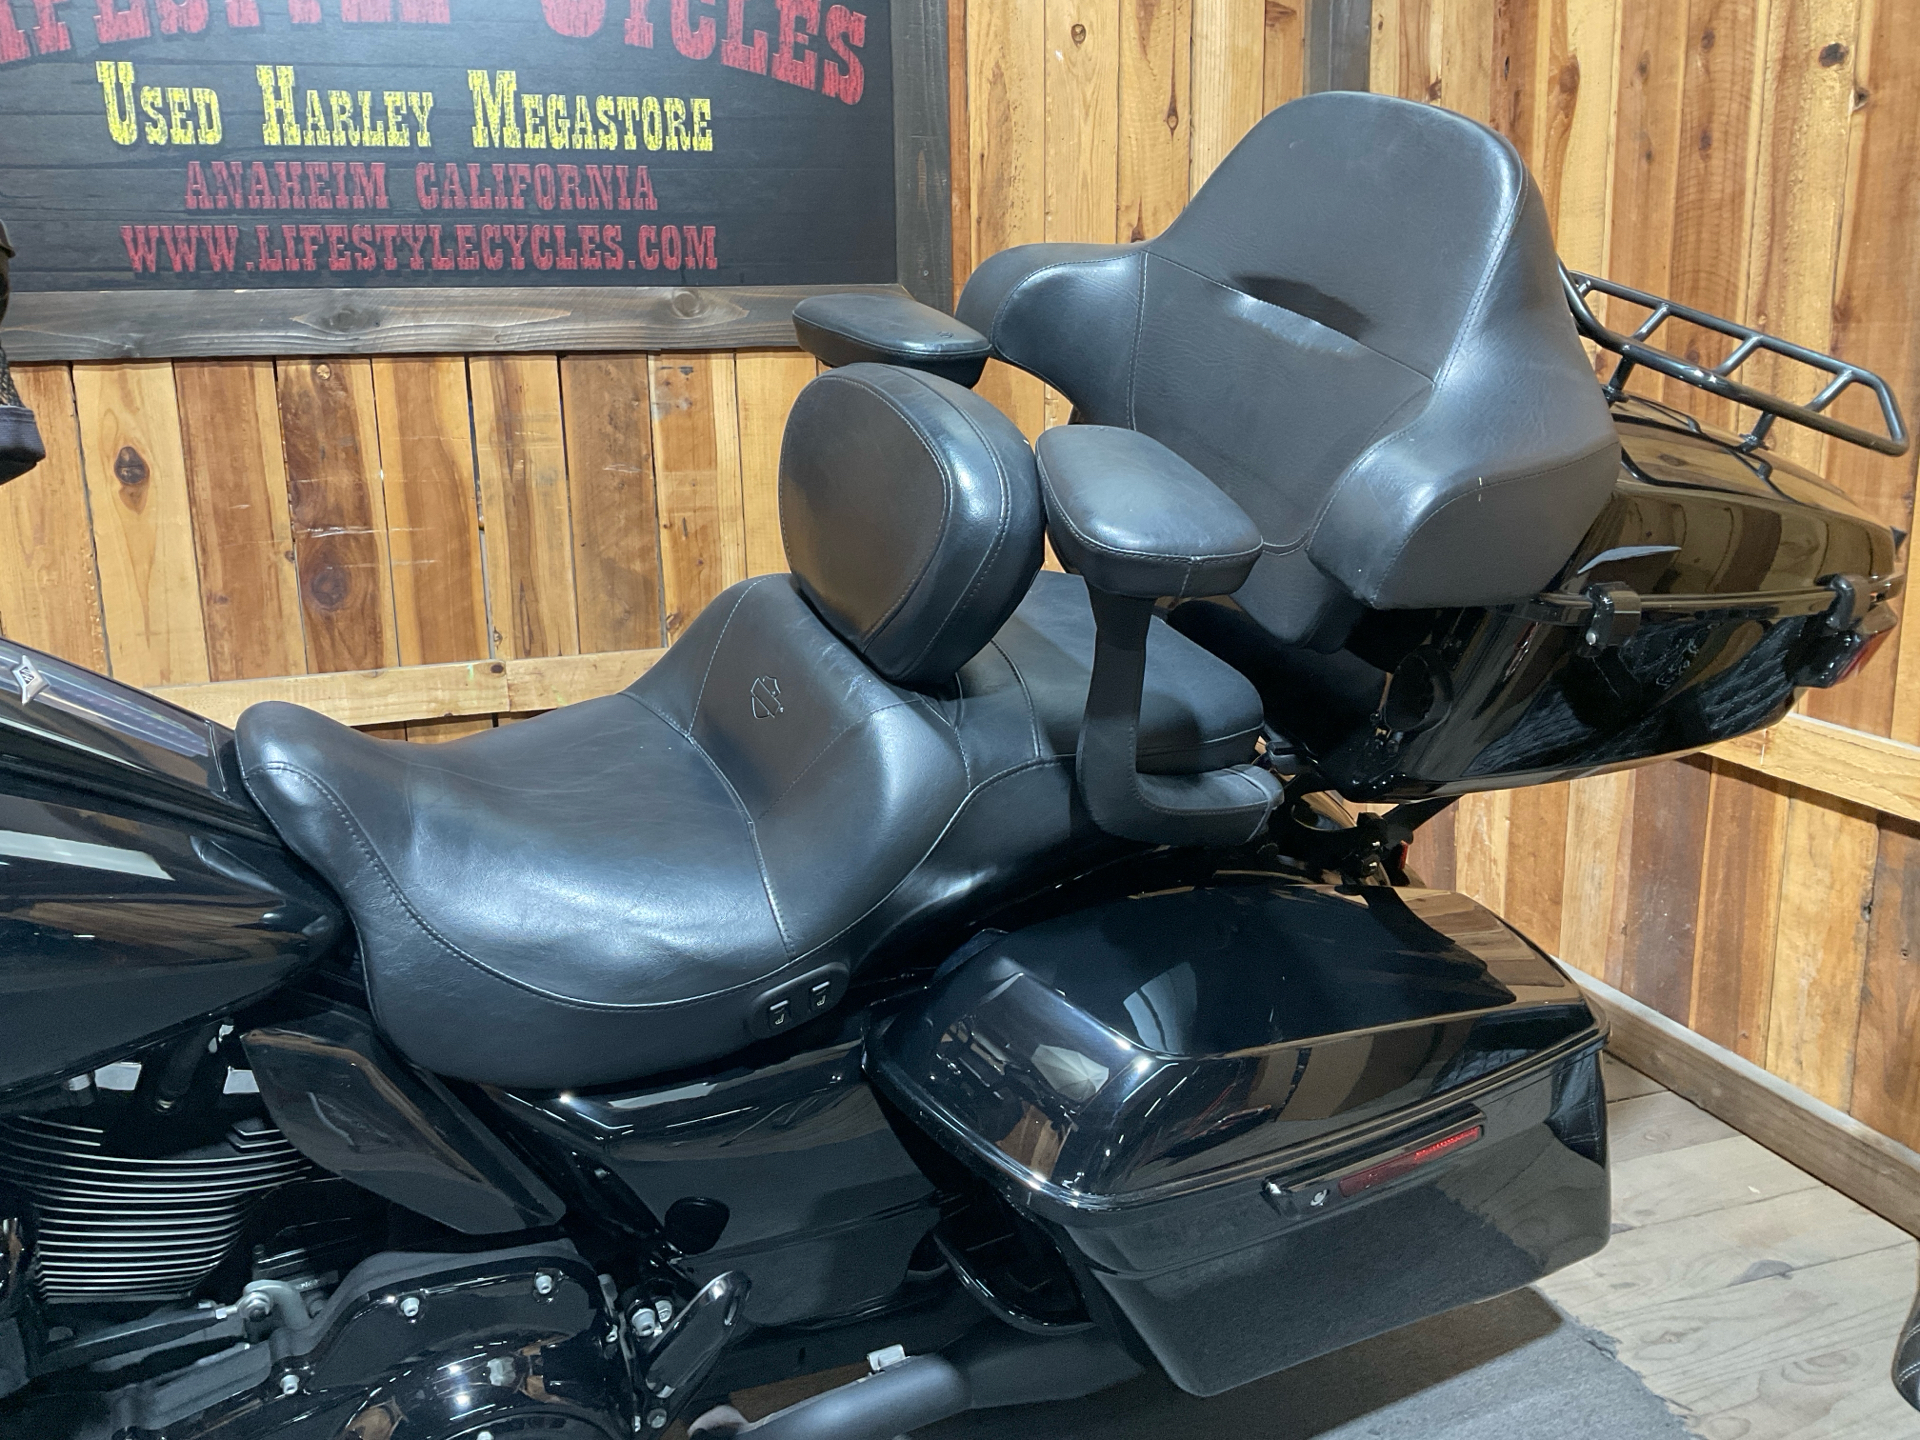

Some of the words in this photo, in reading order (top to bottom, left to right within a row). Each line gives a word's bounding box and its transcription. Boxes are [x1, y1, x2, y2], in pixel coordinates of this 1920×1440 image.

[95, 61, 223, 145] USED
[255, 65, 434, 147] HARLEY
[467, 70, 713, 151] MEGASTORE
[185, 161, 389, 210] ANAHEIM
[415, 162, 658, 210] CALIFORNIA
[120, 224, 718, 272] WWW.LIFESTYLECYCLES.COM
